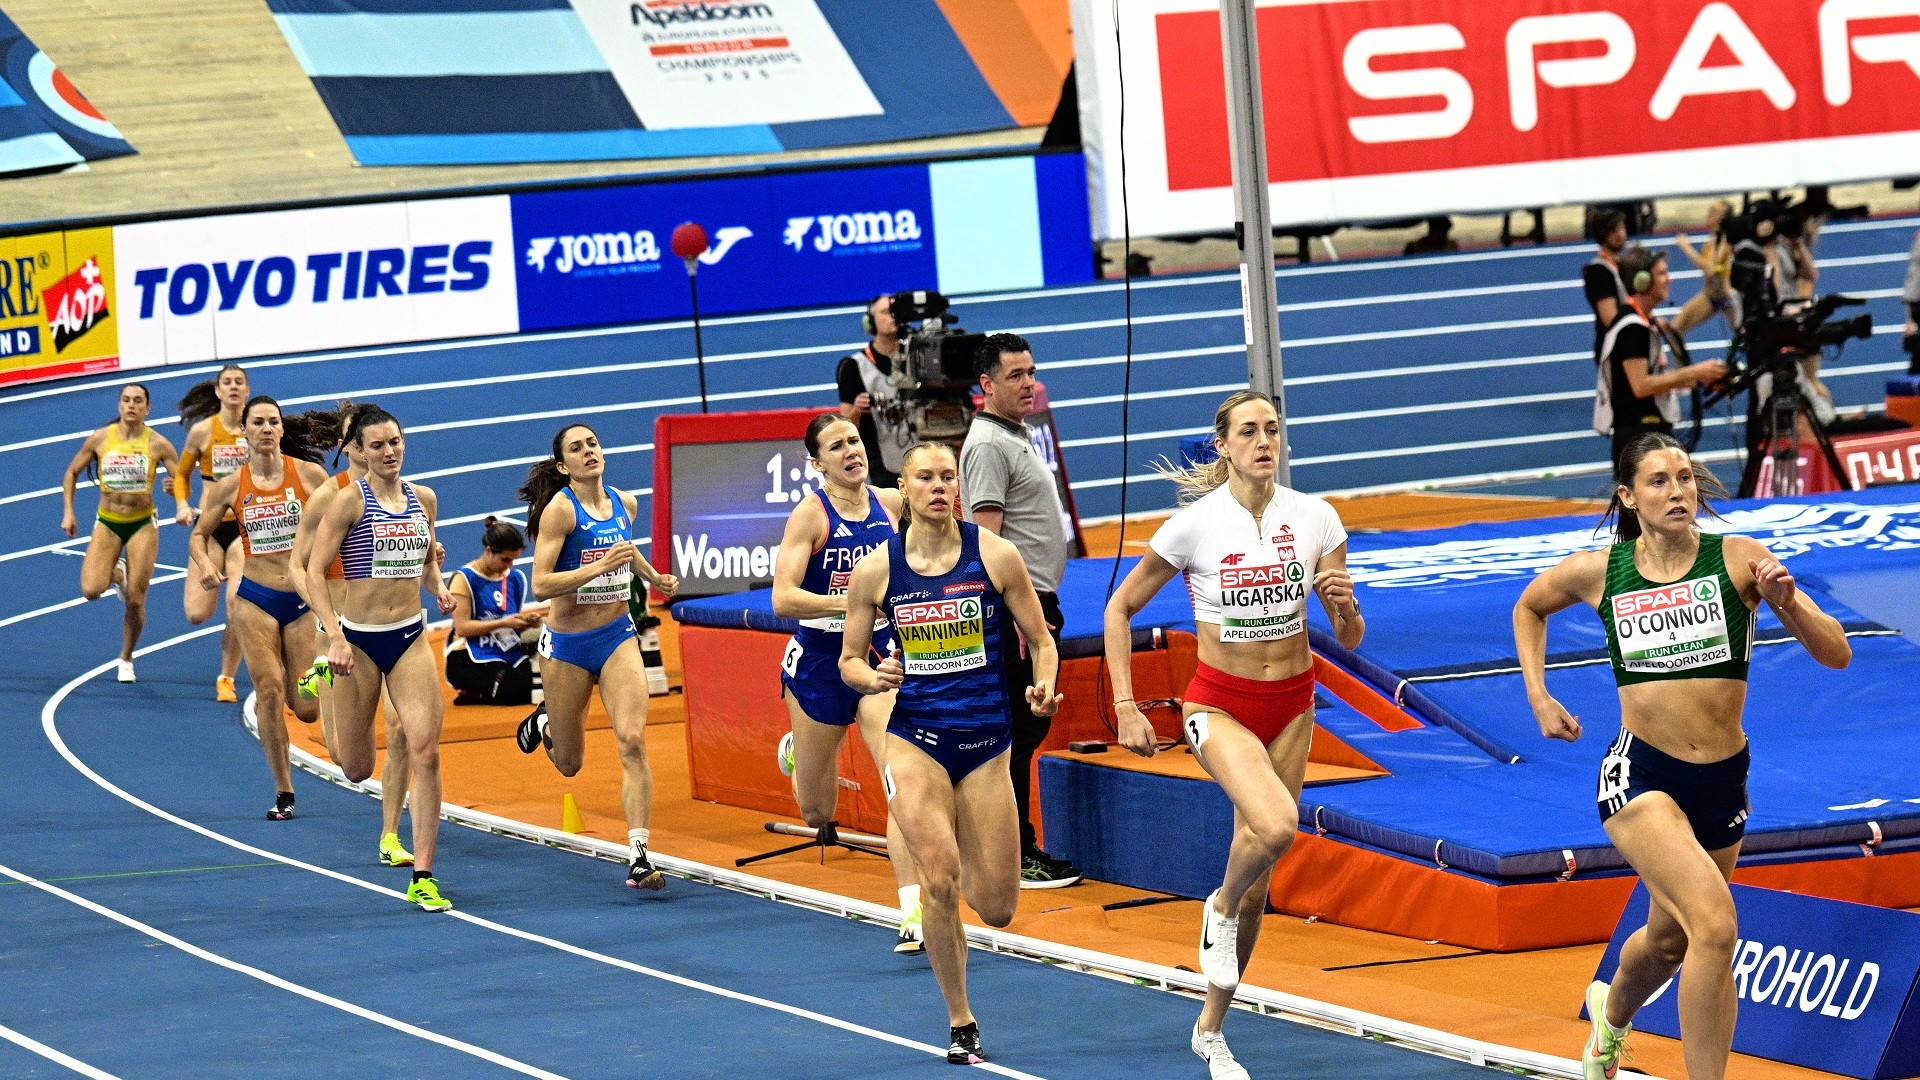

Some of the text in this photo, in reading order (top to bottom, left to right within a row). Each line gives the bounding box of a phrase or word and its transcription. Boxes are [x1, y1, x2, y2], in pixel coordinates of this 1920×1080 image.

[631, 3, 774, 28] Apeldoorn
[657, 51, 801, 73] CHAMPIONSHIPS
[1342, 0, 1920, 144] SPAR
[135, 240, 494, 320] TOYO TIRES
[245, 504, 286, 520] SPAR
[375, 523, 417, 537] SPAR
[375, 537, 429, 552] O'DOWDA
[593, 534, 625, 546] ITALIA
[1273, 534, 1294, 543] ORLEN
[252, 541, 290, 552] APELDOORN
[1220, 553, 1246, 565] 4F
[374, 568, 416, 576] APELDOORN
[1222, 567, 1284, 586] SPAR
[945, 582, 985, 594] motonet
[1221, 583, 1305, 607] LIGARSKA
[579, 593, 620, 602] APELDOORN
[890, 591, 922, 604] CRAFT
[1617, 587, 1690, 615] SPAR
[897, 603, 957, 623] SPAR
[1263, 606, 1269, 615] 5
[1244, 619, 1262, 627] RUN
[1618, 602, 1722, 639] O'CONNOR
[898, 618, 980, 641] VANNINEN
[1224, 622, 1301, 639] APELDOORN 2025
[1669, 631, 1676, 641] 4
[938, 641, 944, 650] 1
[1649, 646, 1670, 657] RUN
[787, 647, 797, 668] 6
[908, 656, 984, 671] APELDOORN 2025
[922, 652, 938, 660] RUN
[1629, 648, 1727, 669] APELDOORN 2025
[1189, 719, 1199, 745] 3
[958, 739, 990, 750] CRAFT
[1731, 938, 1880, 1021] ROHOLD
